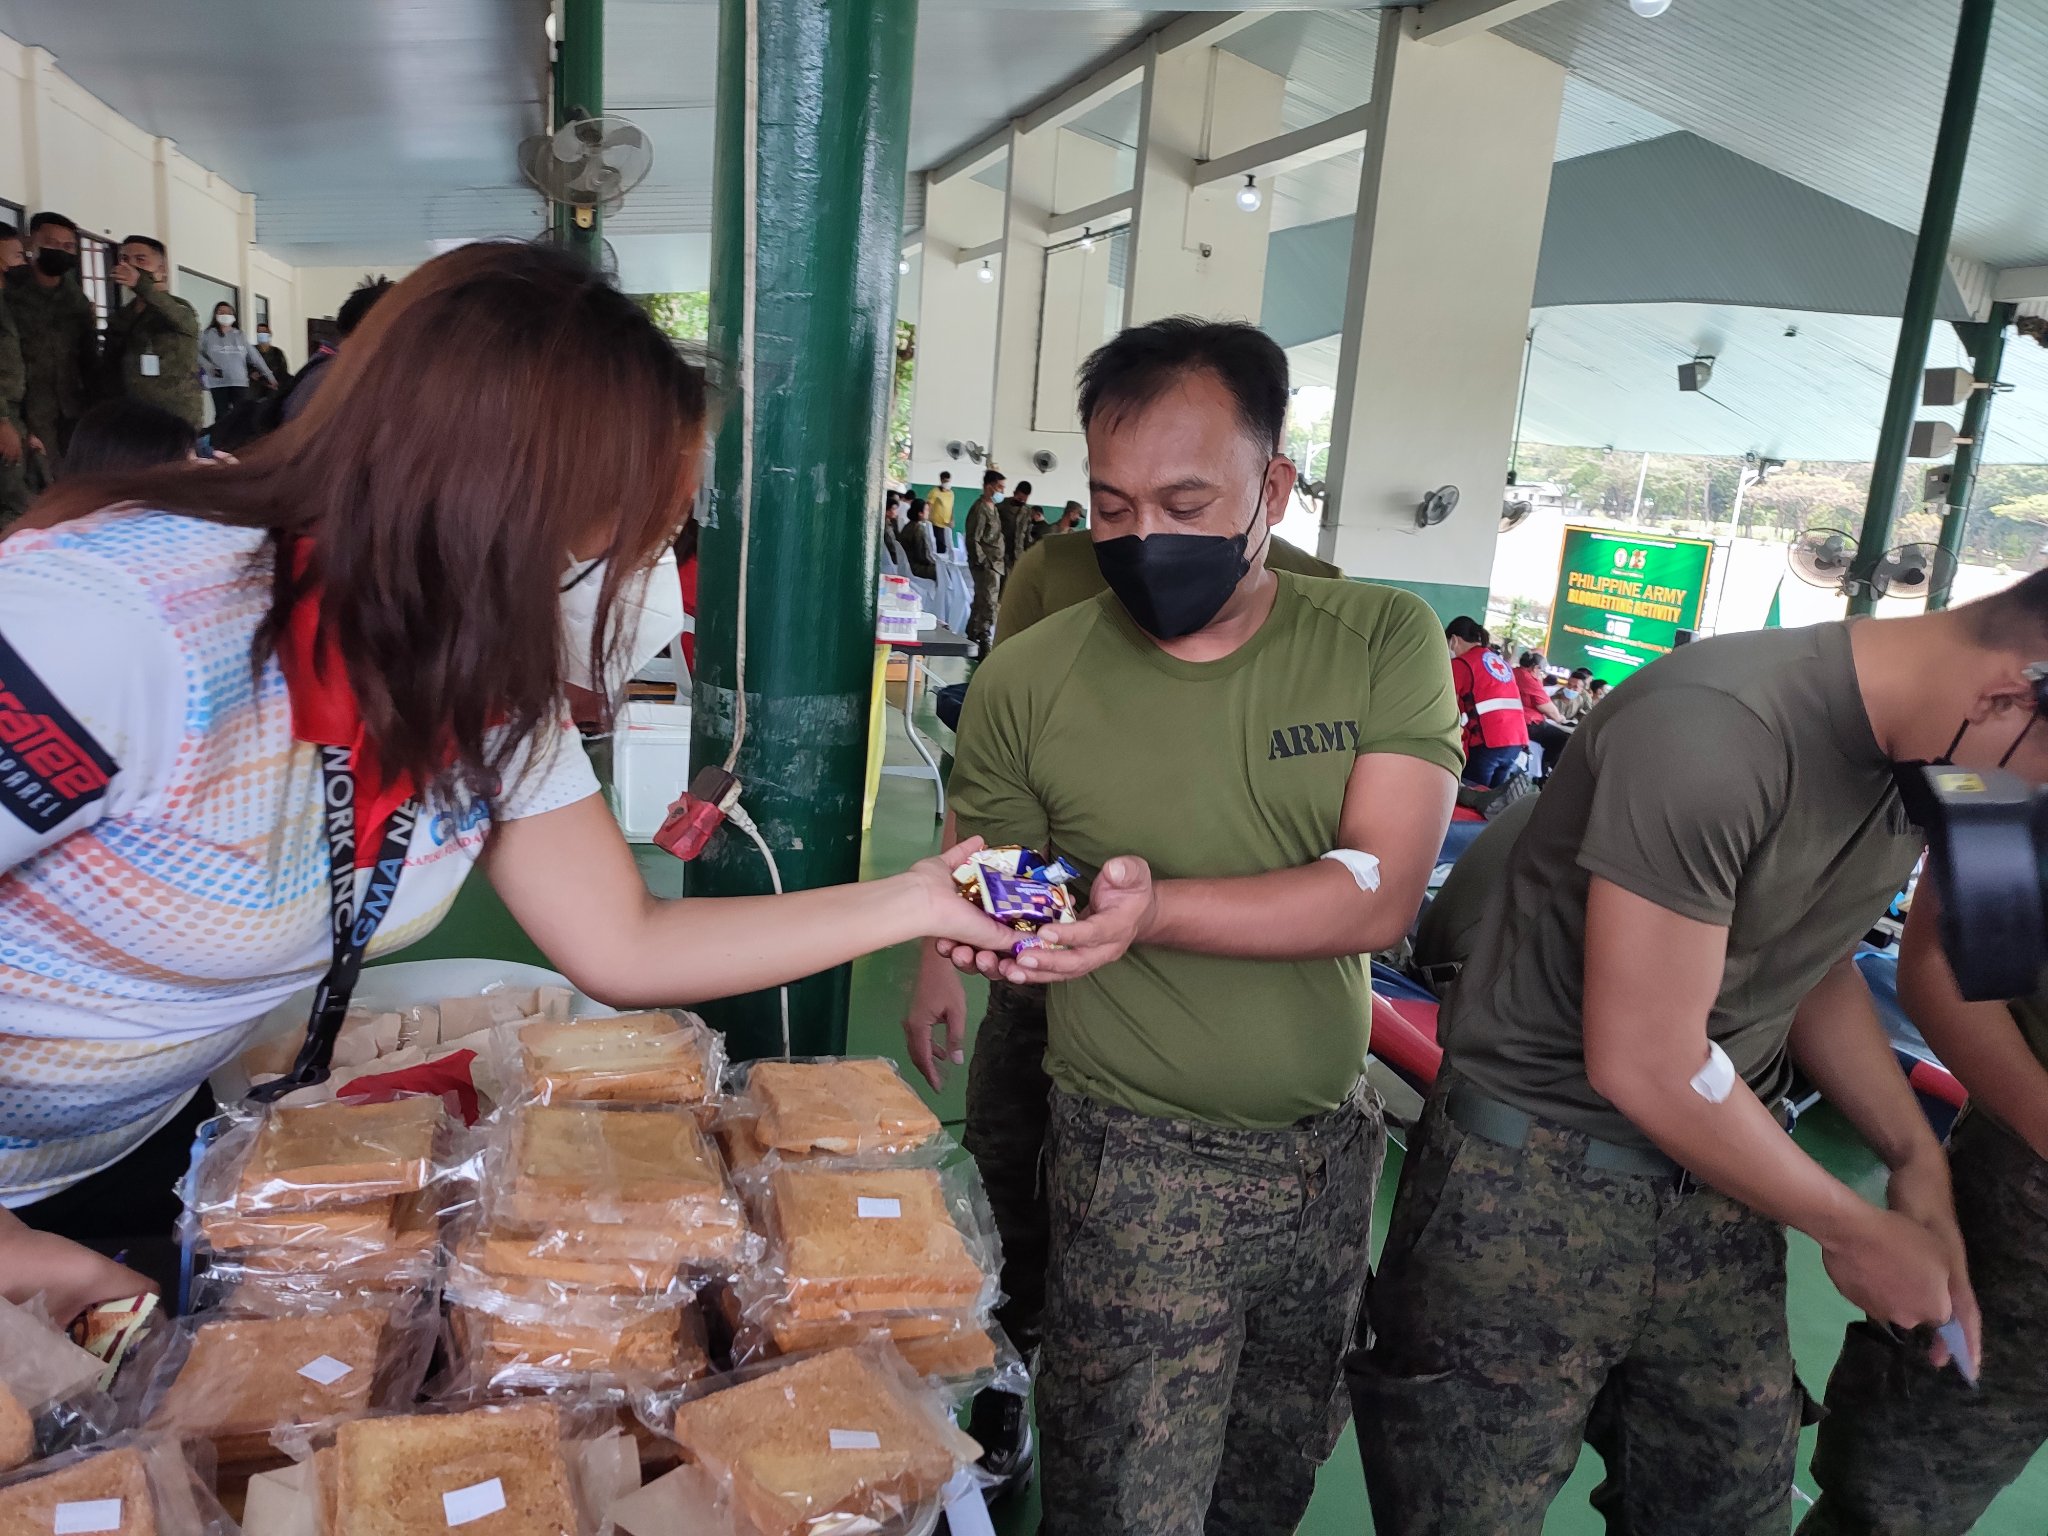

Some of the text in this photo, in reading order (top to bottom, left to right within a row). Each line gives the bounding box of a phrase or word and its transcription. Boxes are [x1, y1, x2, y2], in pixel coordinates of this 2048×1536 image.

[1567, 588, 1682, 624] LLETTING ACTIVITY
[1568, 571, 1643, 598] PHILIPPINE
[1642, 584, 1687, 606] ARMY
[1268, 720, 1360, 760] ARMY
[0, 746, 62, 818] PAREL
[325, 861, 355, 945] INC.
[351, 858, 404, 947] GMA
